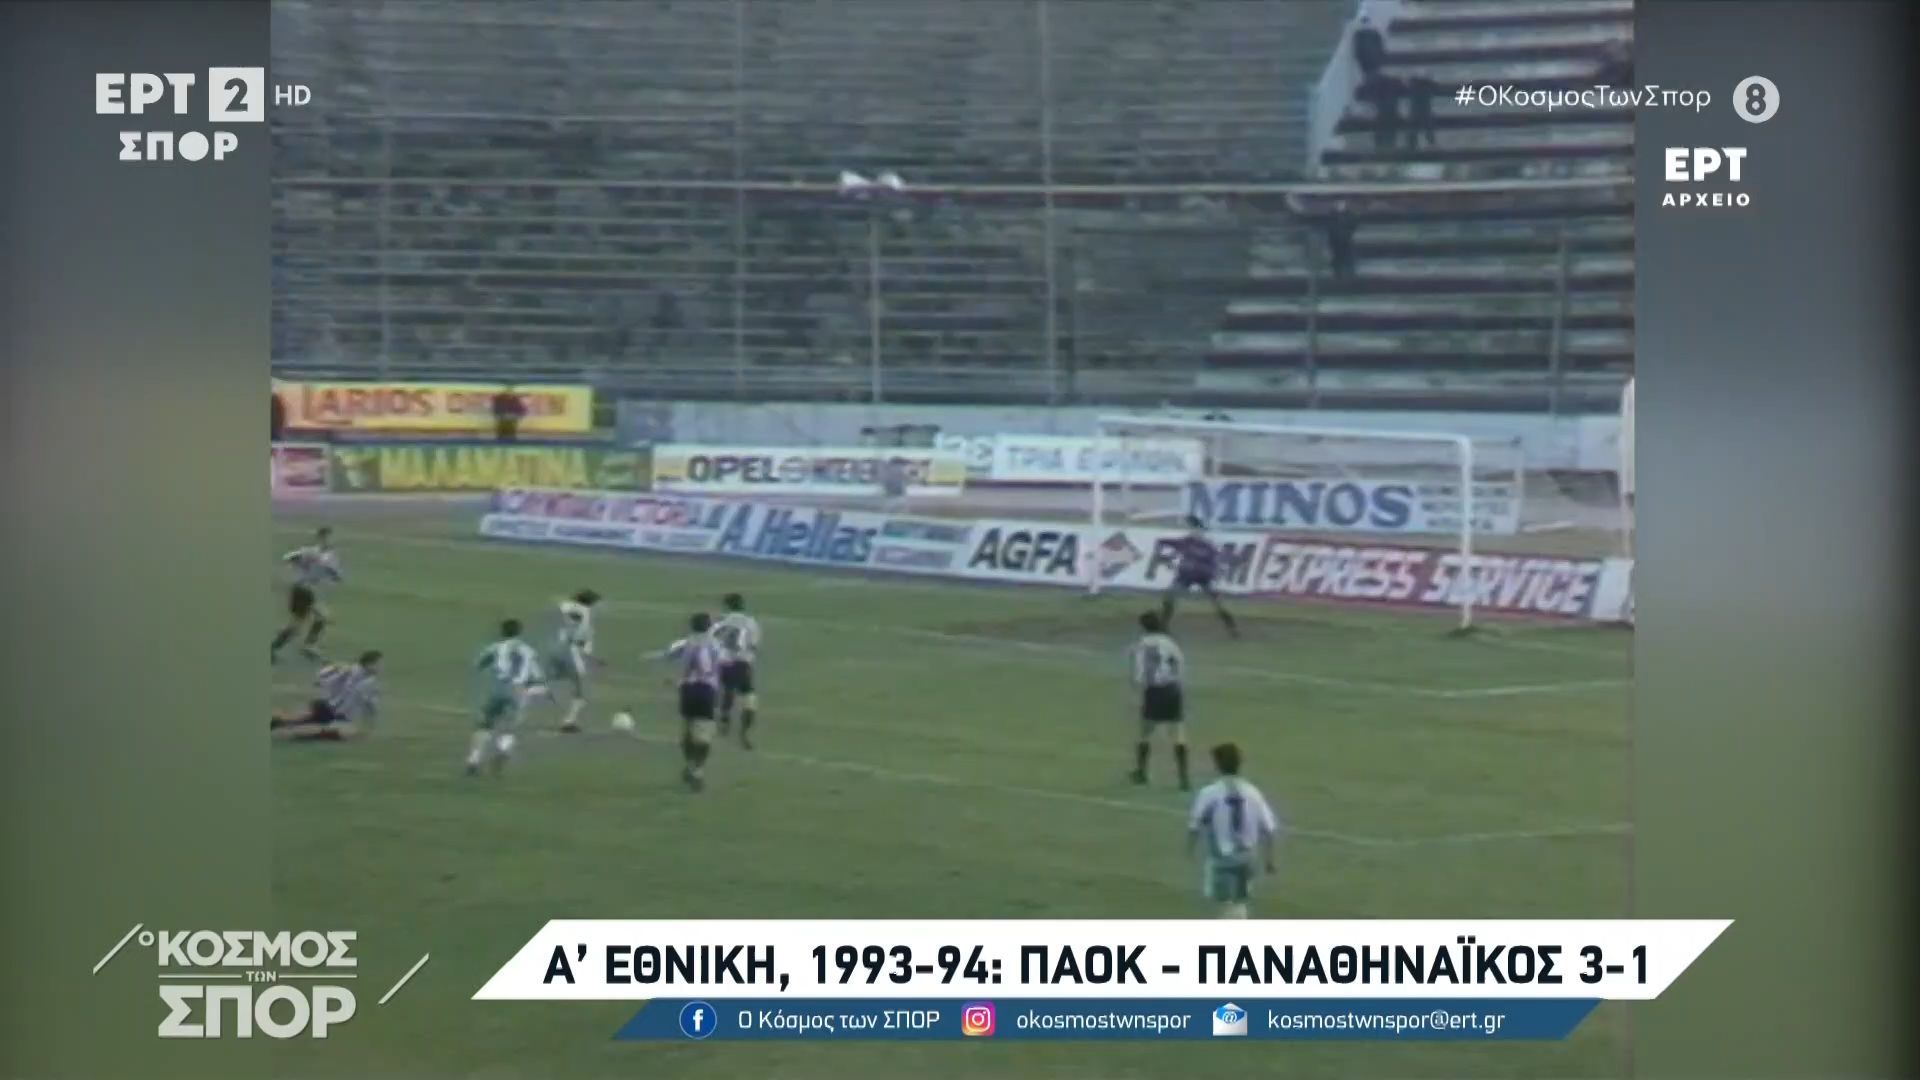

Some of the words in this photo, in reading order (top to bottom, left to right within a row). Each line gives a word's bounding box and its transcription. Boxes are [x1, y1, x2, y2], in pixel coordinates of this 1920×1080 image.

[688, 455, 780, 483] OPEL
[1187, 480, 1414, 530] MINOS
[968, 527, 1079, 576] AGFA
[1261, 543, 1426, 600] EXPRESS
[1421, 552, 1603, 614] SERVICE
